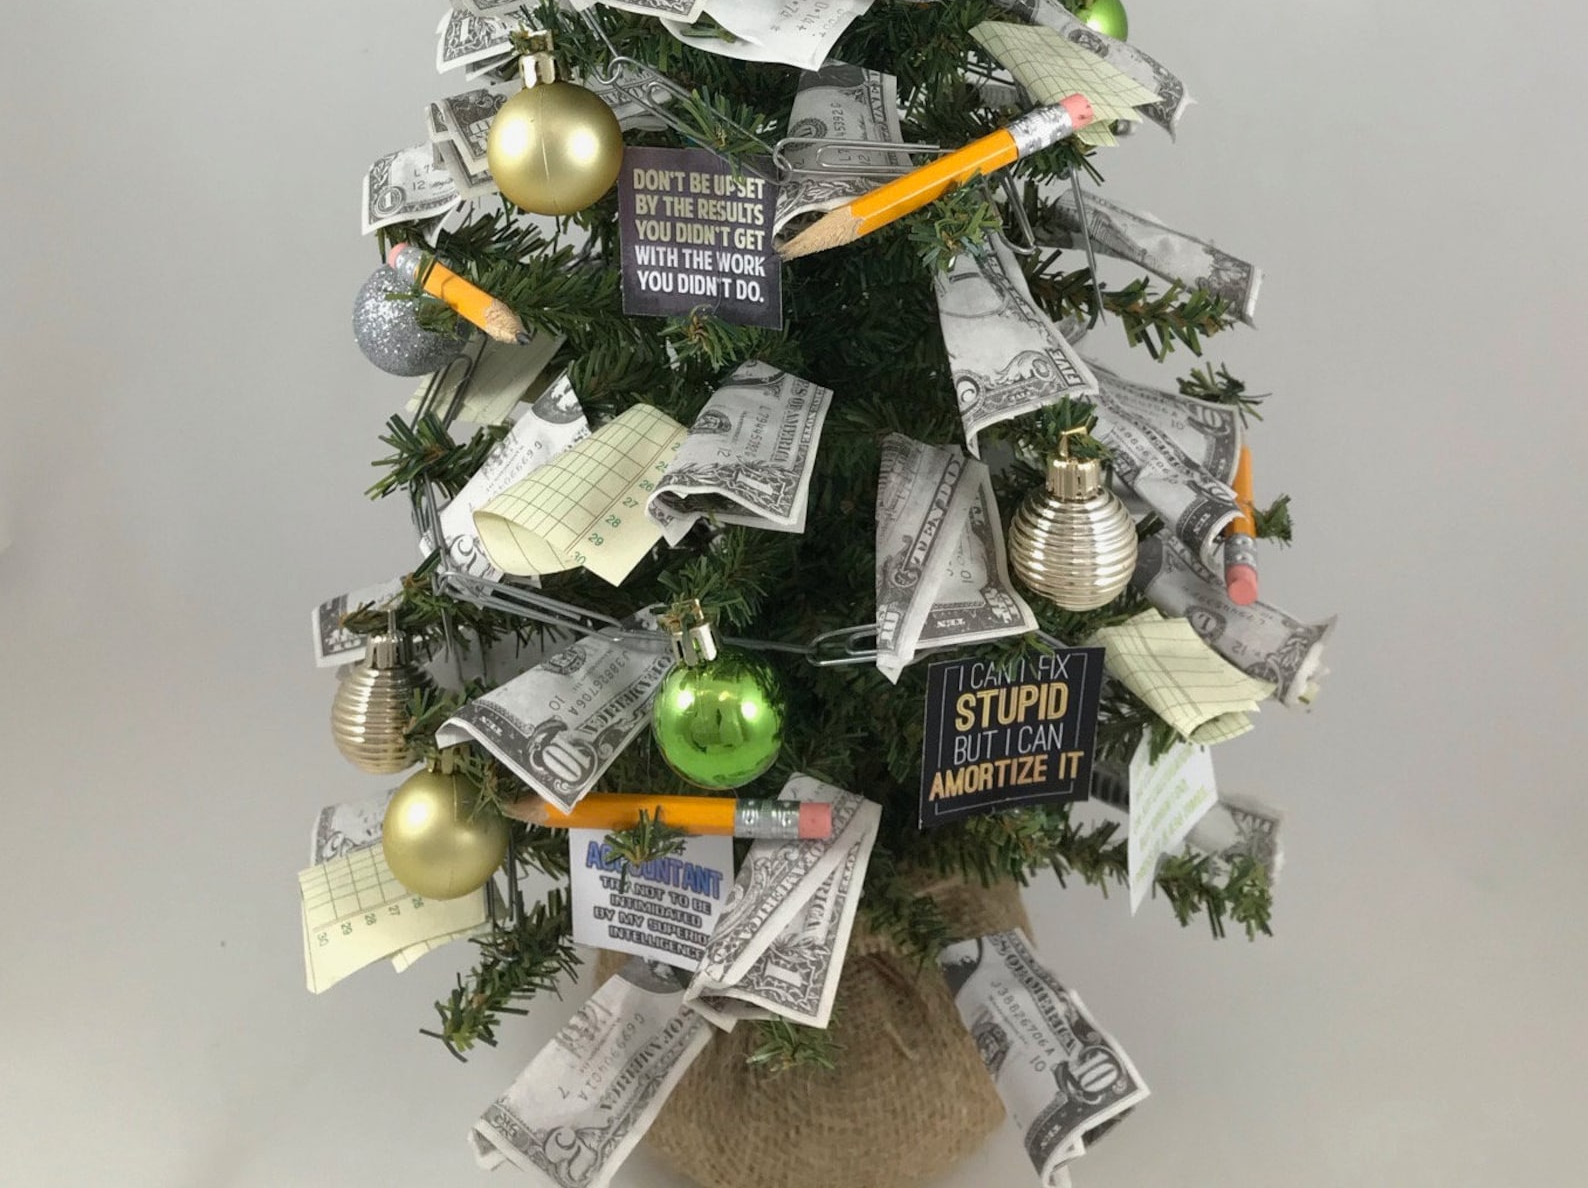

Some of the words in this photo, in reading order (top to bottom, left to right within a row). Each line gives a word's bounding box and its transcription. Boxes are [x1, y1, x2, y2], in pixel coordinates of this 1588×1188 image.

[633, 168, 686, 192] DON'T
[689, 172, 710, 194] BE
[714, 174, 765, 199] UPSET
[635, 194, 661, 215] BY
[663, 196, 694, 218] THE
[697, 198, 764, 225] RESULTS
[635, 220, 672, 242] YOU
[676, 222, 731, 247] DIDN'T
[734, 227, 765, 251] GET
[634, 245, 678, 268] WITH
[682, 248, 713, 271] THE
[716, 252, 766, 277] WORK
[637, 270, 673, 293] YOU
[678, 273, 732, 298] DIDN'T
[736, 279, 765, 303] DO.
[622, 496, 639, 509] 27
[605, 514, 622, 528] 28
[588, 532, 604, 547] 29
[958, 665, 964, 692] I
[955, 682, 1069, 732] STUPID
[954, 729, 999, 766] BUT
[1005, 728, 1011, 756] I
[1017, 722, 1064, 754] CAN
[928, 754, 1049, 802] AMORTIZE
[1058, 751, 1085, 780] IT
[610, 893, 702, 929] INTIMIDATED
[634, 882, 666, 901] NOT
[668, 890, 689, 908] TO
[692, 897, 712, 916] BE
[593, 906, 615, 921] BY
[618, 911, 645, 928] MY
[647, 918, 711, 947] SUPERIO
